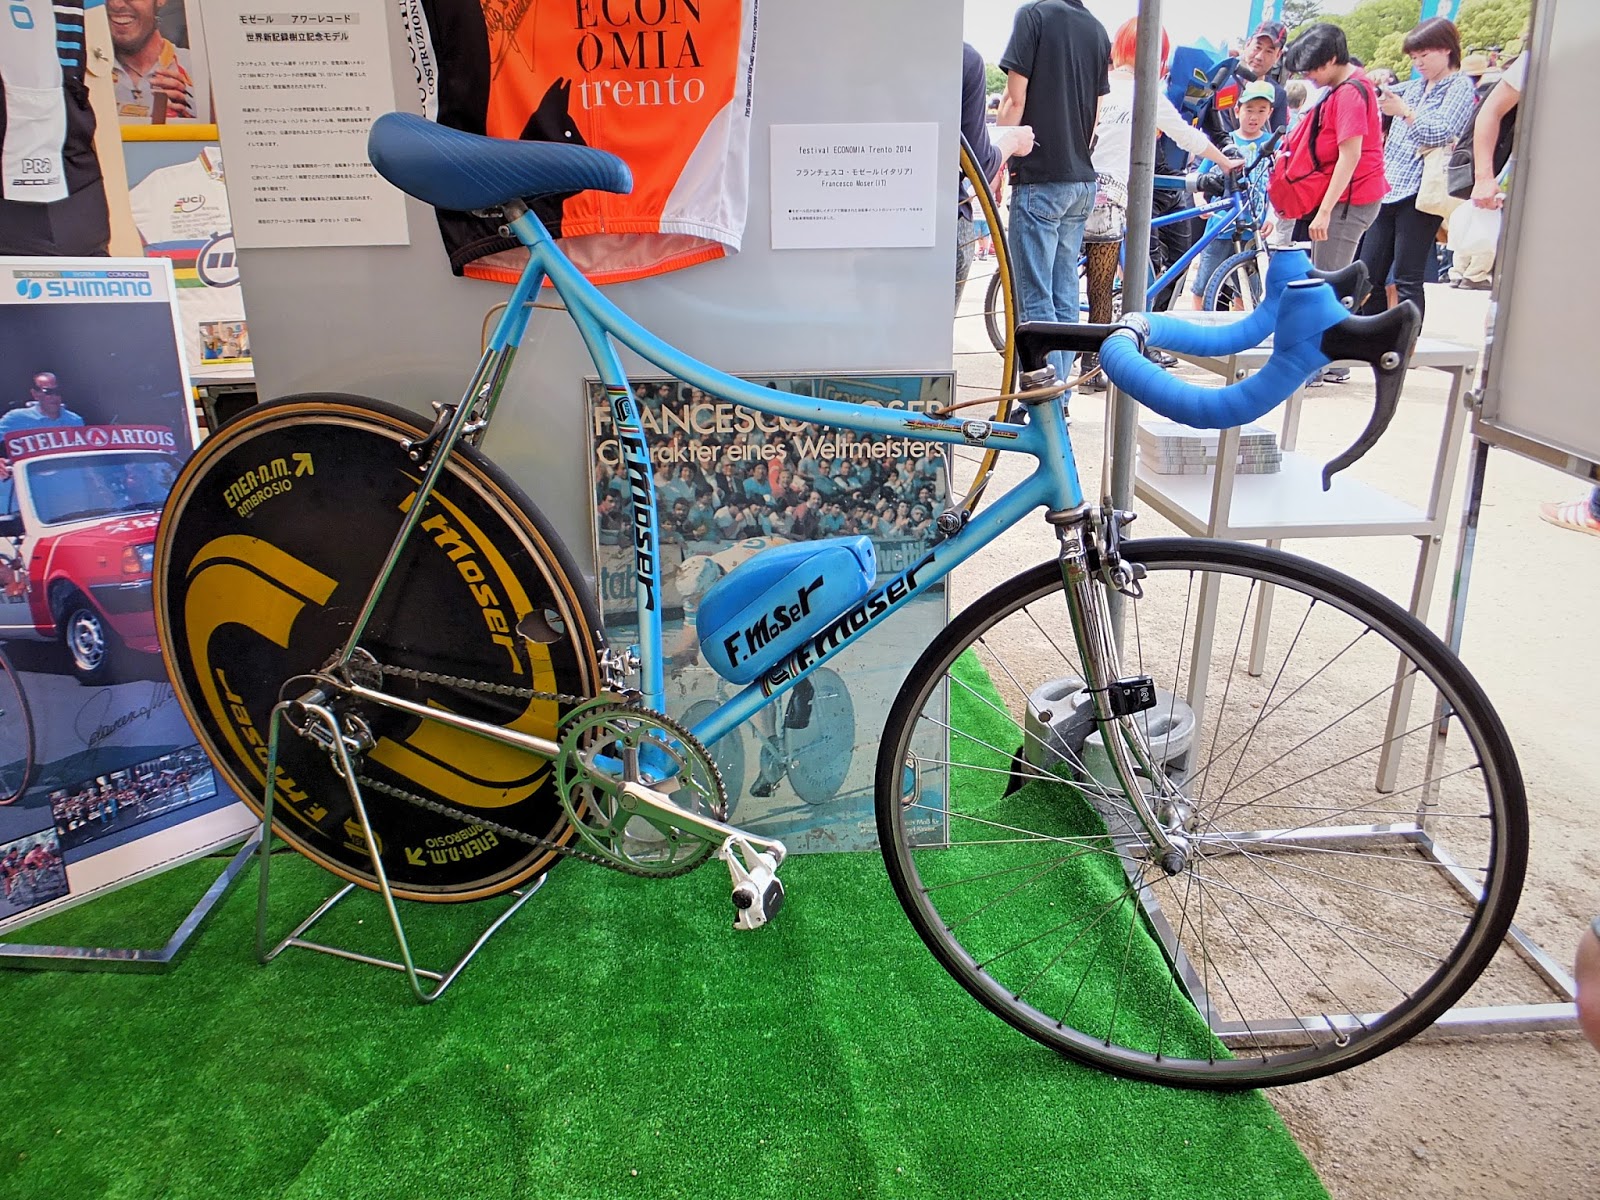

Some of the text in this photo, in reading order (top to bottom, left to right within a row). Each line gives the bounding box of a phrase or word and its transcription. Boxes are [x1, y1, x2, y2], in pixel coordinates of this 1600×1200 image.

[239, 14, 351, 24] モゼール アワーレコード
[574, 0, 701, 29] ECON
[576, 29, 704, 73] OMIA
[577, 73, 705, 110] trento
[799, 145, 912, 155] festival ECONOMIA Trento 2014
[821, 179, 854, 188] Francesco
[45, 280, 153, 297] SHIMANO
[594, 403, 808, 436] FANCESC
[8, 429, 176, 457] STELLA ARTOIS
[596, 433, 945, 465] Crakter eines Weltmeisters
[237, 478, 292, 518] AMBROSIO
